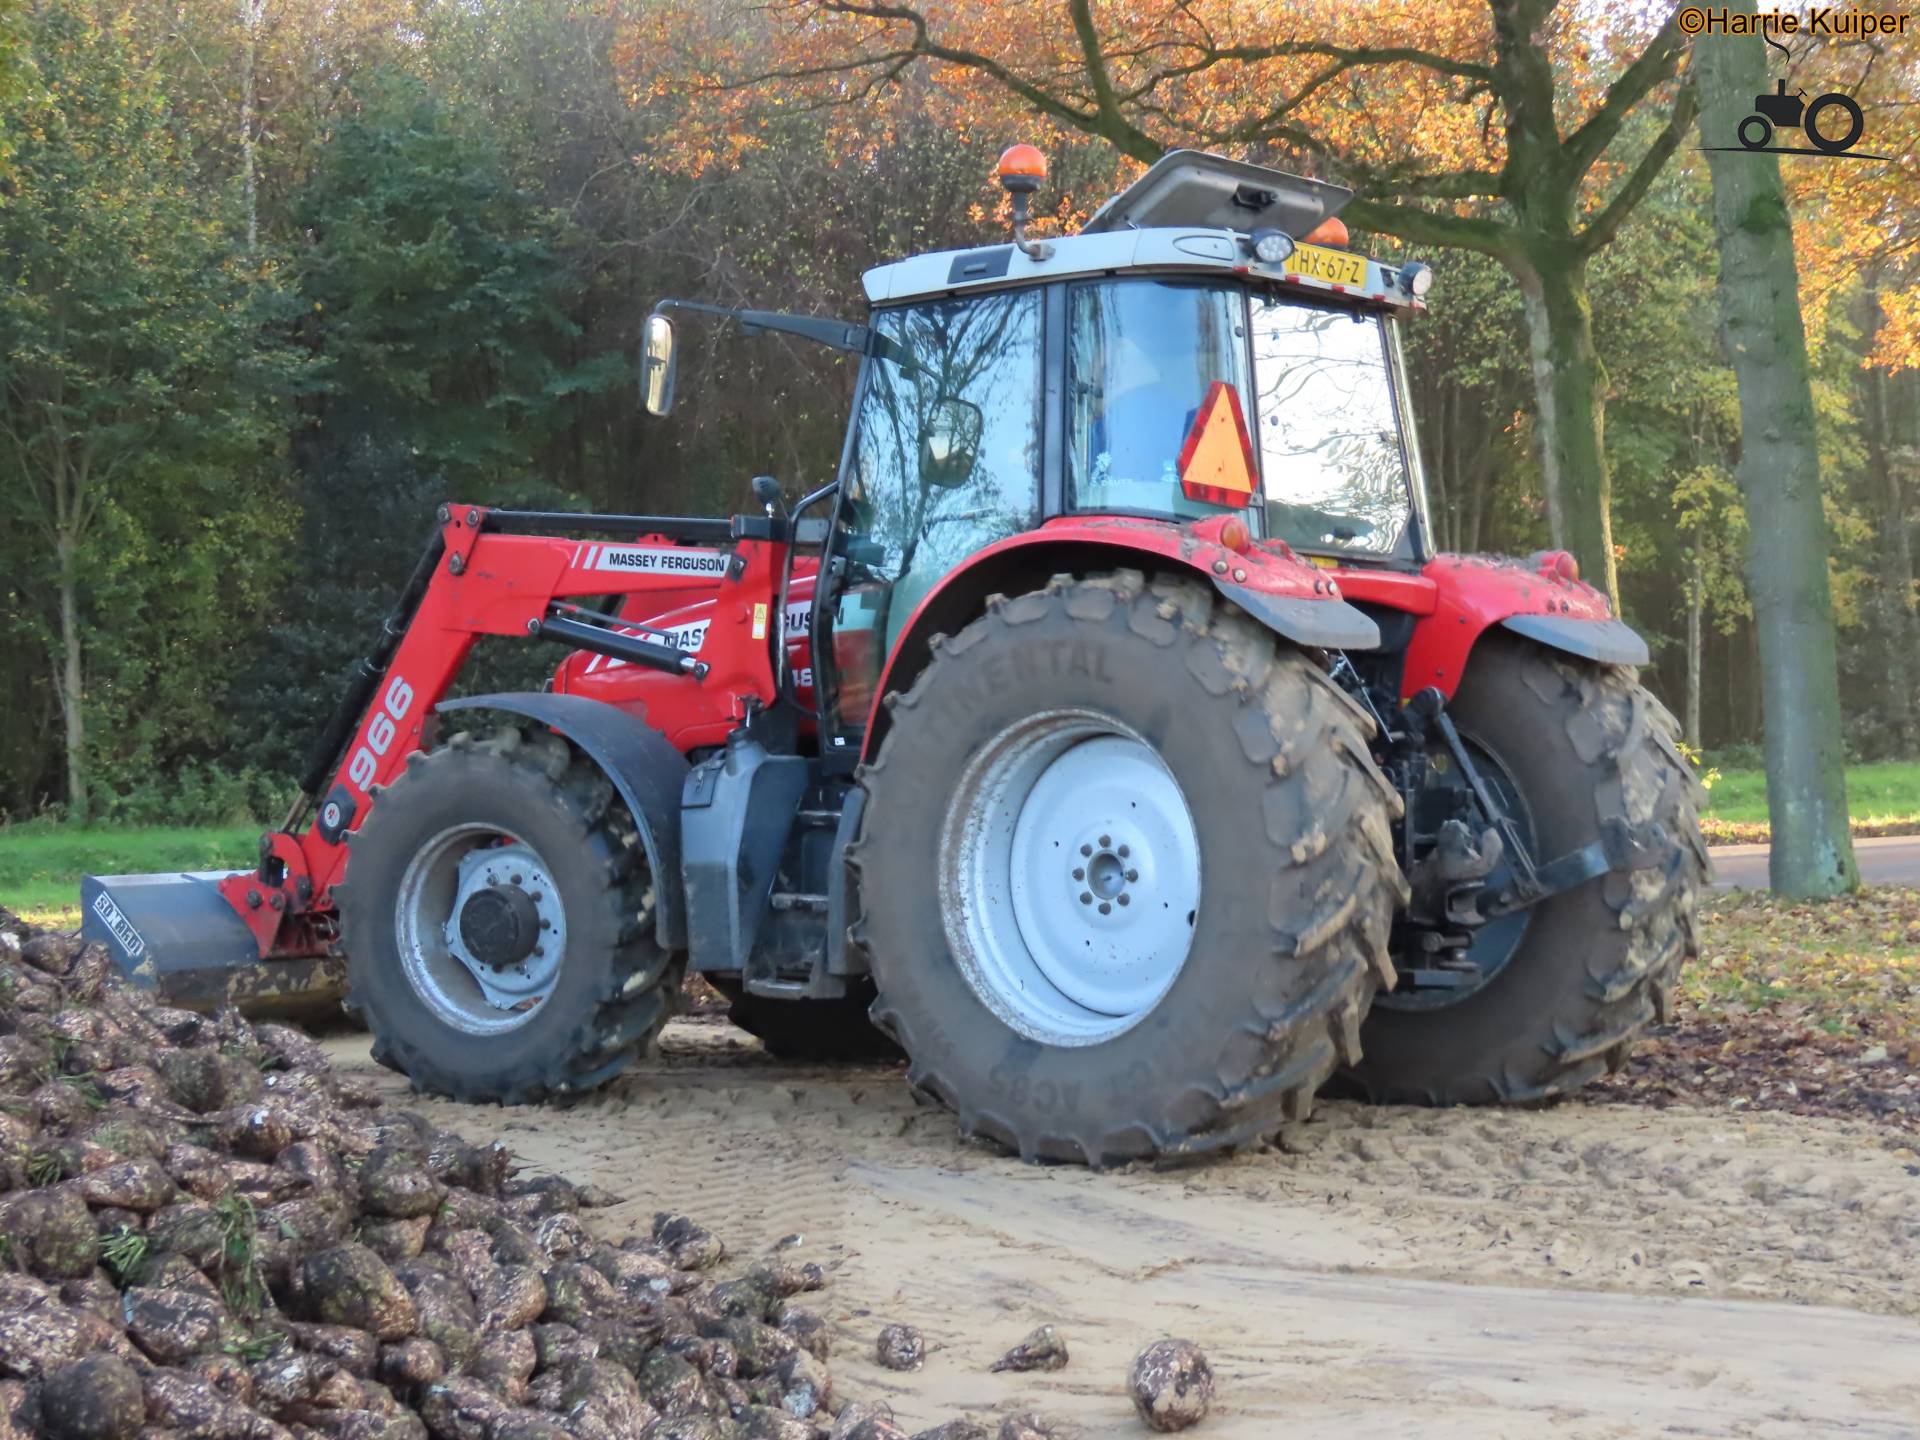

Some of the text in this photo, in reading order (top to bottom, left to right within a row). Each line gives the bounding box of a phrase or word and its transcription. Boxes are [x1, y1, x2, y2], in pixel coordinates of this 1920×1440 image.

[609, 553, 725, 572] MASSEY FERGUSON
[349, 676, 414, 792] 966
